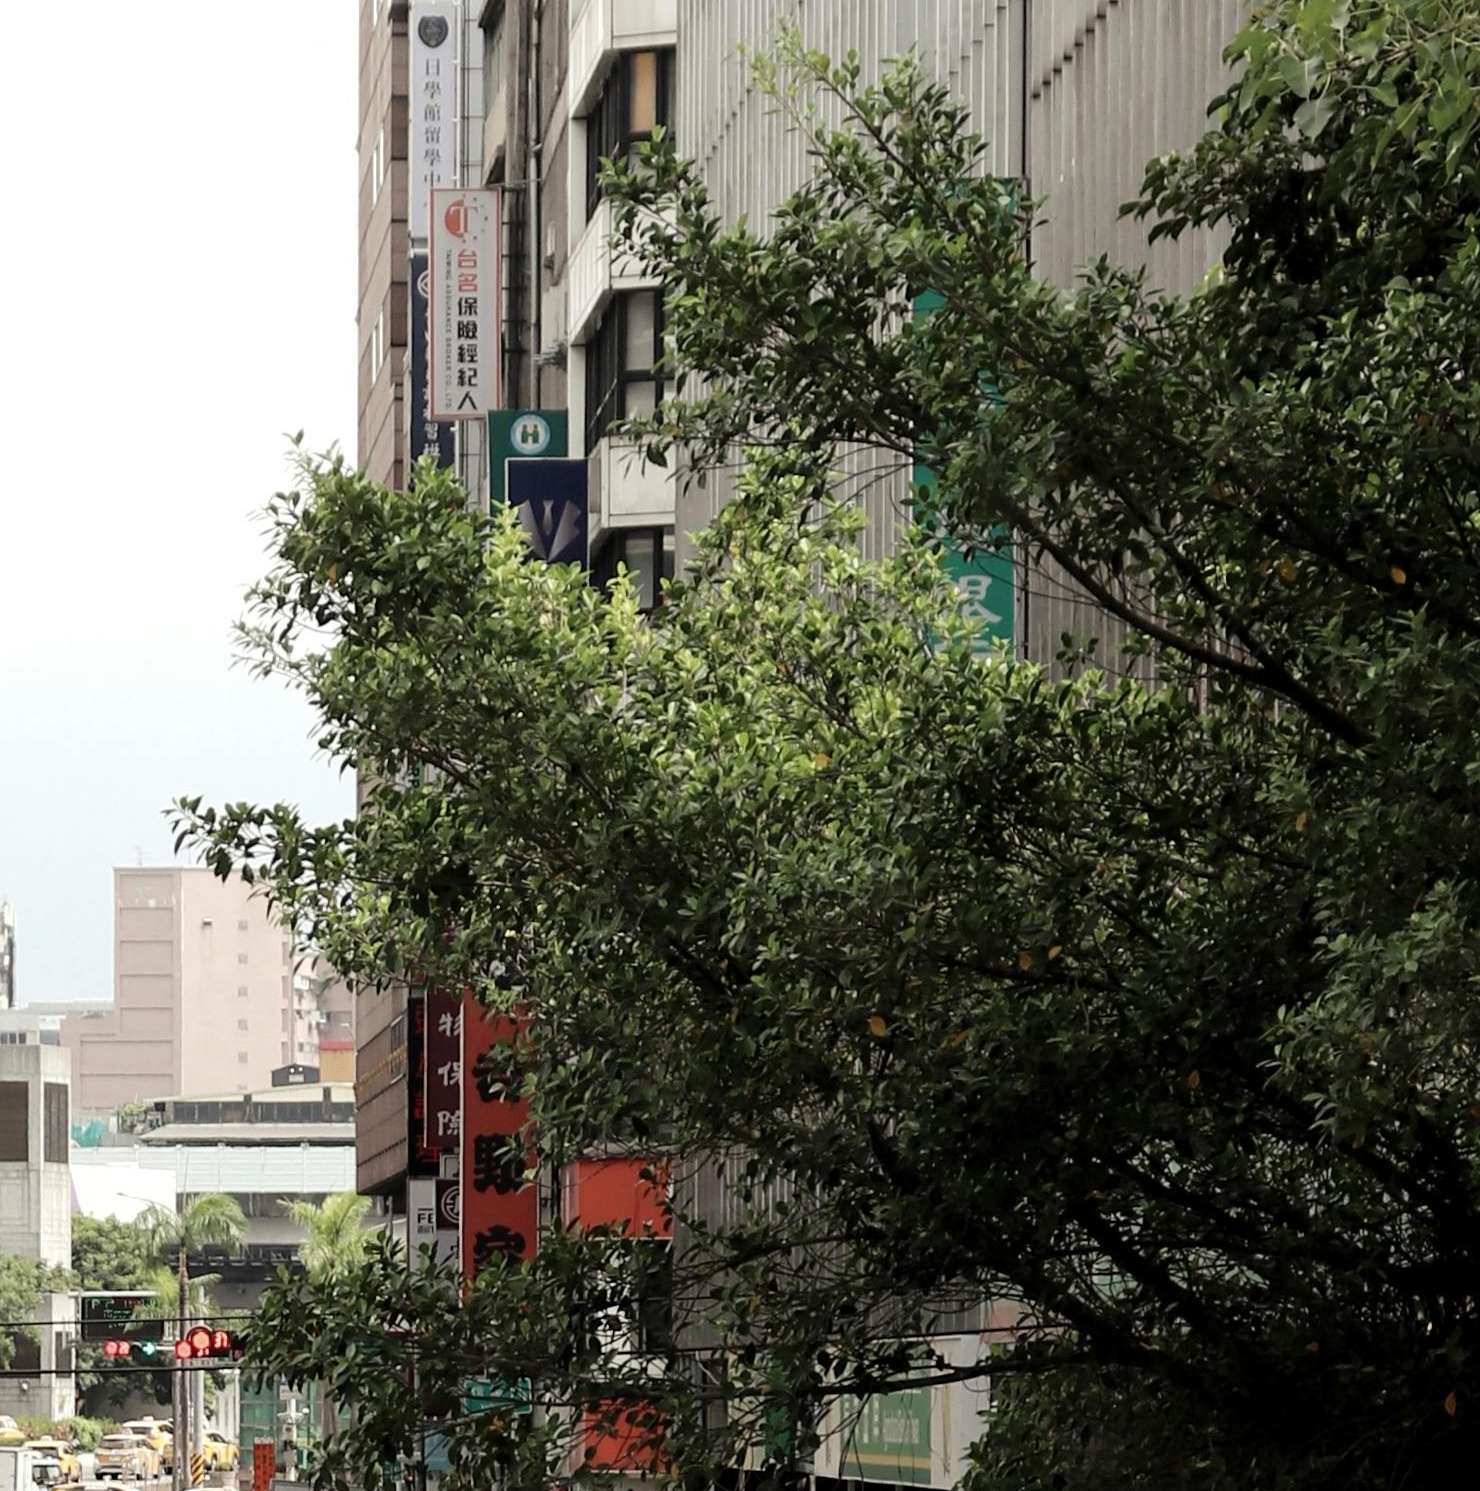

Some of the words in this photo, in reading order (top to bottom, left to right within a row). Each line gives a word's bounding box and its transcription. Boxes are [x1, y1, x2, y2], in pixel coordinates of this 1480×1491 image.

[457, 248, 479, 411] 台名保險經紀人
